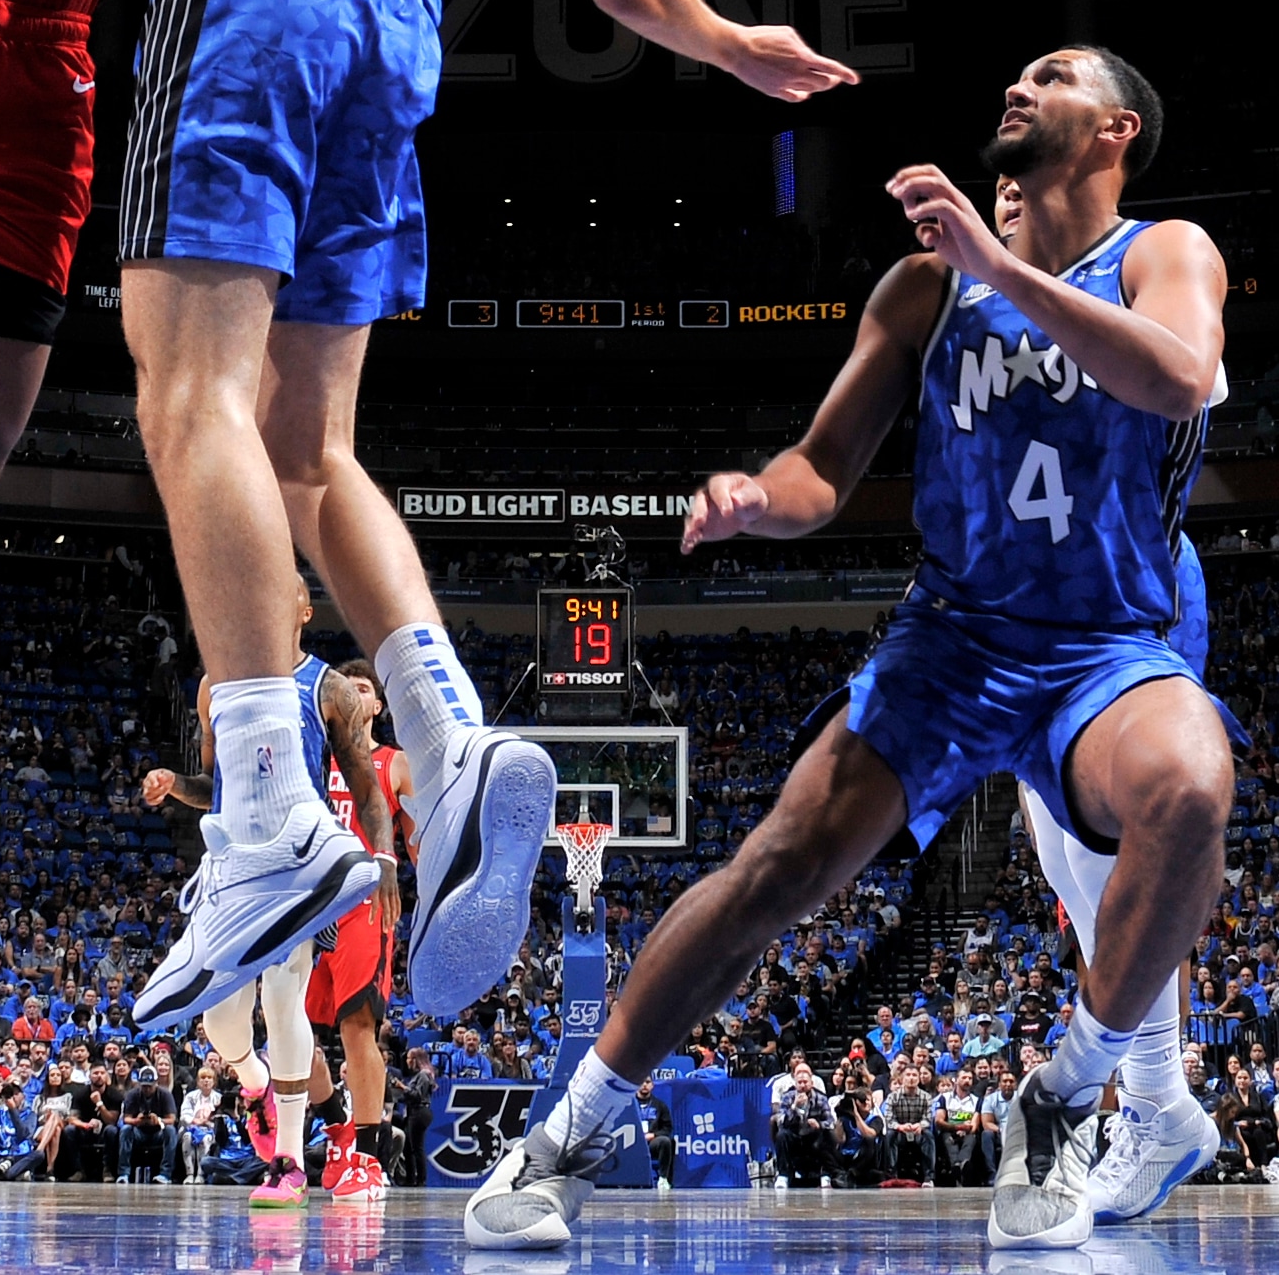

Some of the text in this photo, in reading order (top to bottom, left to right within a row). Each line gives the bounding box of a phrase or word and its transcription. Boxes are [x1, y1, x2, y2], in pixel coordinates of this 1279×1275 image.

[84, 284, 107, 297] TIME
[98, 297, 120, 309] LEFT
[539, 303, 599, 324] 9:41
[633, 302, 666, 316] 1st
[739, 302, 847, 323] ROCKETS
[478, 305, 491, 323] 3
[632, 319, 665, 327] PERIOD
[706, 305, 720, 323] 2
[1007, 439, 1074, 545] 4
[403, 494, 695, 517] BUD LIGHT BASELIN
[566, 598, 618, 622] 9:41
[574, 624, 612, 665] 19
[565, 672, 625, 685] TISSOT
[565, 1000, 602, 1026] 35
[675, 1134, 750, 1156] Health
